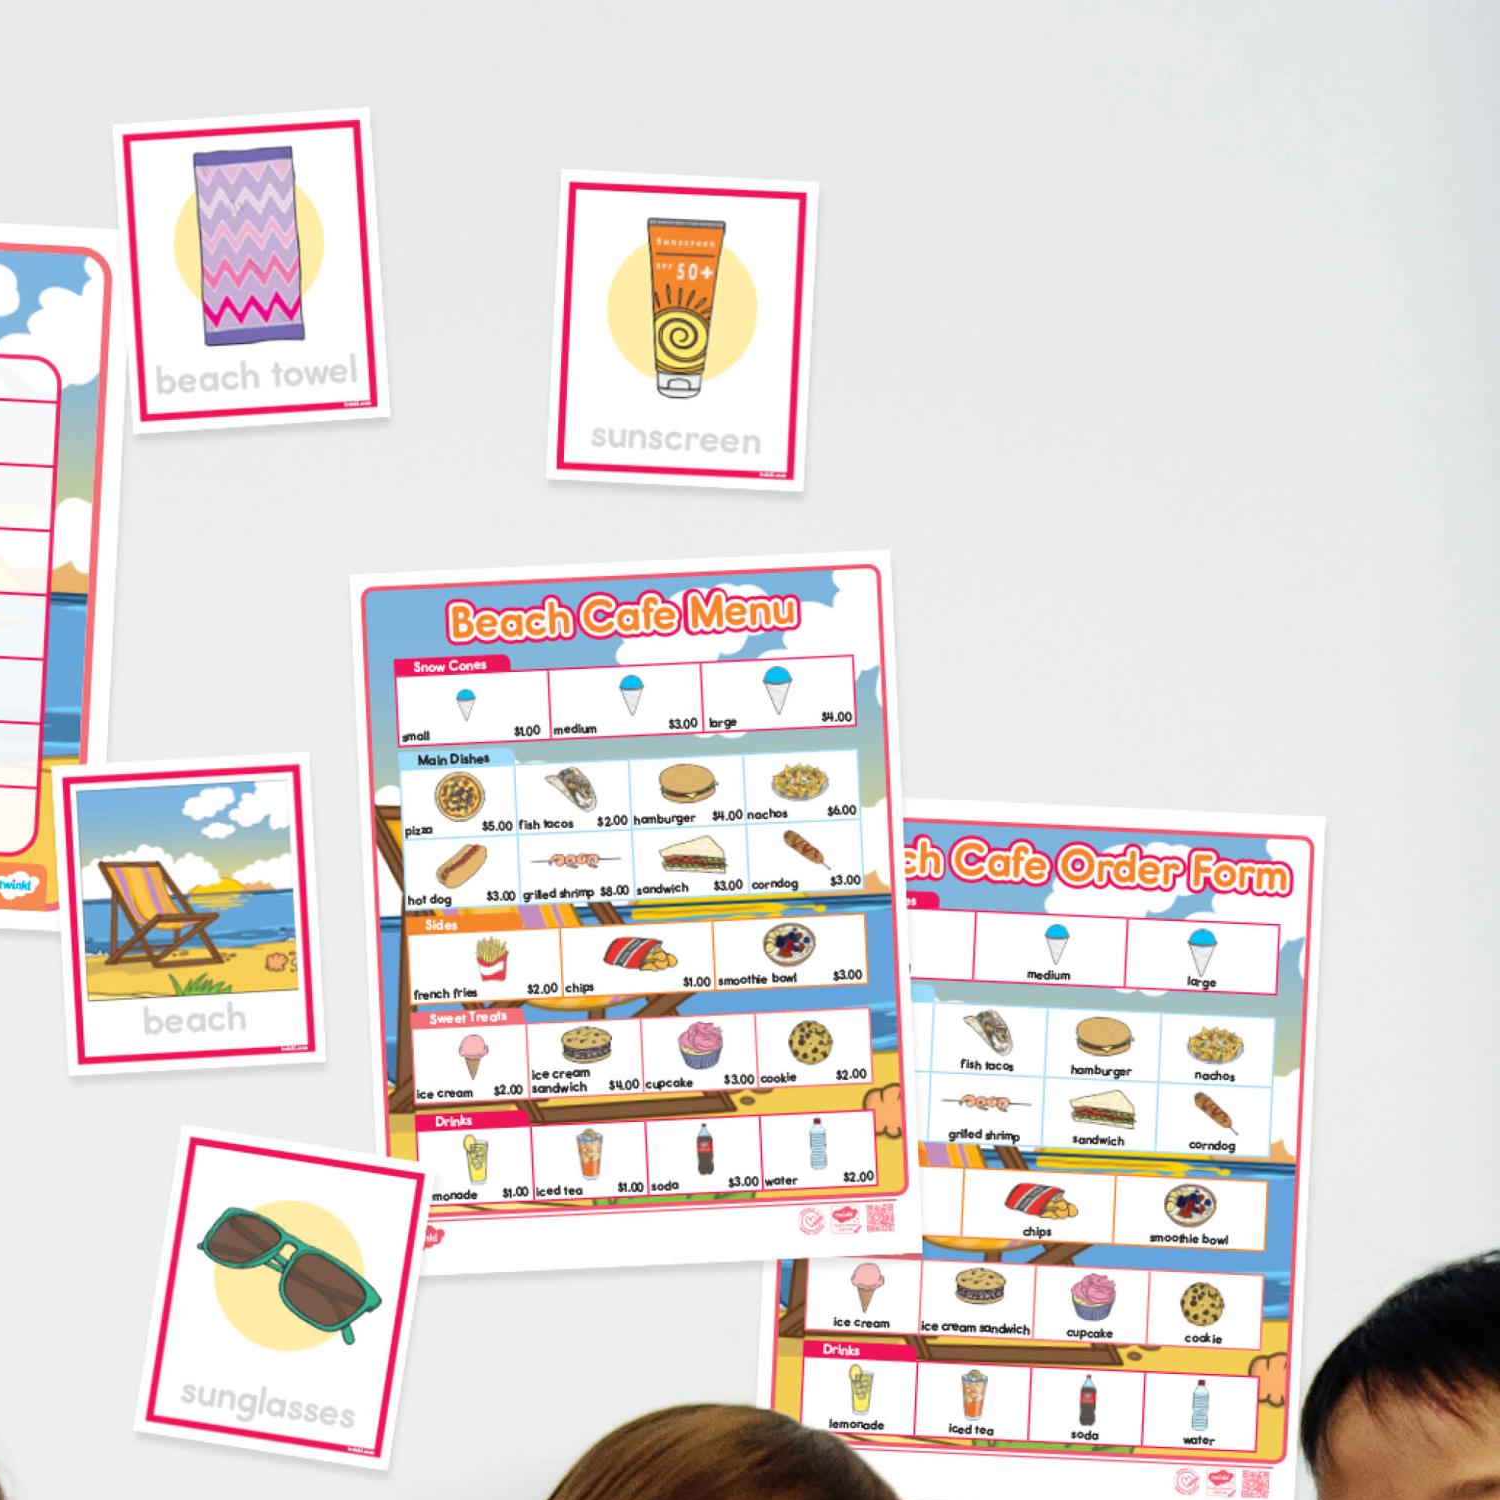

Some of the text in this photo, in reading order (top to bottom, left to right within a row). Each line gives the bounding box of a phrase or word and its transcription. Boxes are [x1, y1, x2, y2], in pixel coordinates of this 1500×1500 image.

[155, 353, 358, 395] beach towel
[591, 427, 762, 455] sunscreen
[446, 589, 800, 645] Beach Cafe Menu
[413, 659, 487, 673] Snow Cones
[668, 716, 699, 730] $3.00
[821, 710, 853, 723] $4.00
[553, 723, 598, 736] medium
[708, 717, 738, 730] large
[401, 730, 431, 743] small
[417, 752, 491, 767] Main Dishes
[712, 808, 744, 822] $4.00
[746, 807, 789, 820] nachos
[827, 804, 857, 817] $6.00
[481, 820, 514, 832] $5.00
[518, 818, 574, 831] fish tacos
[596, 814, 629, 828] $2.00
[633, 813, 697, 826] hamburger
[404, 825, 434, 839] pizza
[950, 837, 1052, 884] Cafe
[1057, 843, 1185, 891] Order
[1187, 849, 1293, 898] Form
[713, 878, 744, 892] $3.00
[751, 877, 799, 892] corndog
[830, 874, 862, 887] $3.00
[599, 884, 630, 897] $8.00
[636, 881, 689, 896] sandwich
[407, 893, 453, 907] hot dog
[486, 890, 517, 902] $3.00
[522, 887, 596, 904] grilled shrimp
[424, 918, 457, 931] Sides
[717, 972, 798, 986] smoothie bowl
[1026, 969, 1071, 981] medium
[564, 982, 595, 995] chips
[1186, 974, 1217, 991] large
[413, 987, 478, 1001] french fries
[143, 1000, 247, 1036] beach
[429, 1010, 508, 1025] Sweet Treats
[960, 1058, 1014, 1072] fish tacos
[531, 1068, 591, 1081] ice cream
[760, 1071, 797, 1084] cookie
[1070, 1064, 1133, 1080] hamburger
[1194, 1070, 1236, 1083] nachos
[531, 1080, 588, 1094] sandwich
[644, 1077, 694, 1091] cupcake
[416, 1089, 474, 1100] ice cream
[435, 1115, 472, 1127] Drinks
[948, 1128, 1021, 1147] grilled shrimp
[1072, 1134, 1125, 1147] sandwich
[1188, 1140, 1236, 1154] corndog
[651, 1180, 680, 1192] soda
[764, 1175, 798, 1187] water
[431, 1189, 478, 1202] monade
[535, 1184, 584, 1197] iced tea
[1022, 1226, 1052, 1239] chips
[1149, 1233, 1229, 1246] smoothie bowl
[833, 1316, 891, 1329] ice cream
[920, 1320, 1031, 1336] ice cream sandwich
[1066, 1328, 1114, 1340] cupcake
[1184, 1333, 1223, 1345] cookie
[823, 1343, 860, 1356] Drinks
[179, 1383, 356, 1432] sunglasses
[828, 1418, 885, 1431] lemonade
[948, 1423, 995, 1437] iced tea
[1070, 1429, 1100, 1441] soda
[1182, 1435, 1216, 1446] water
